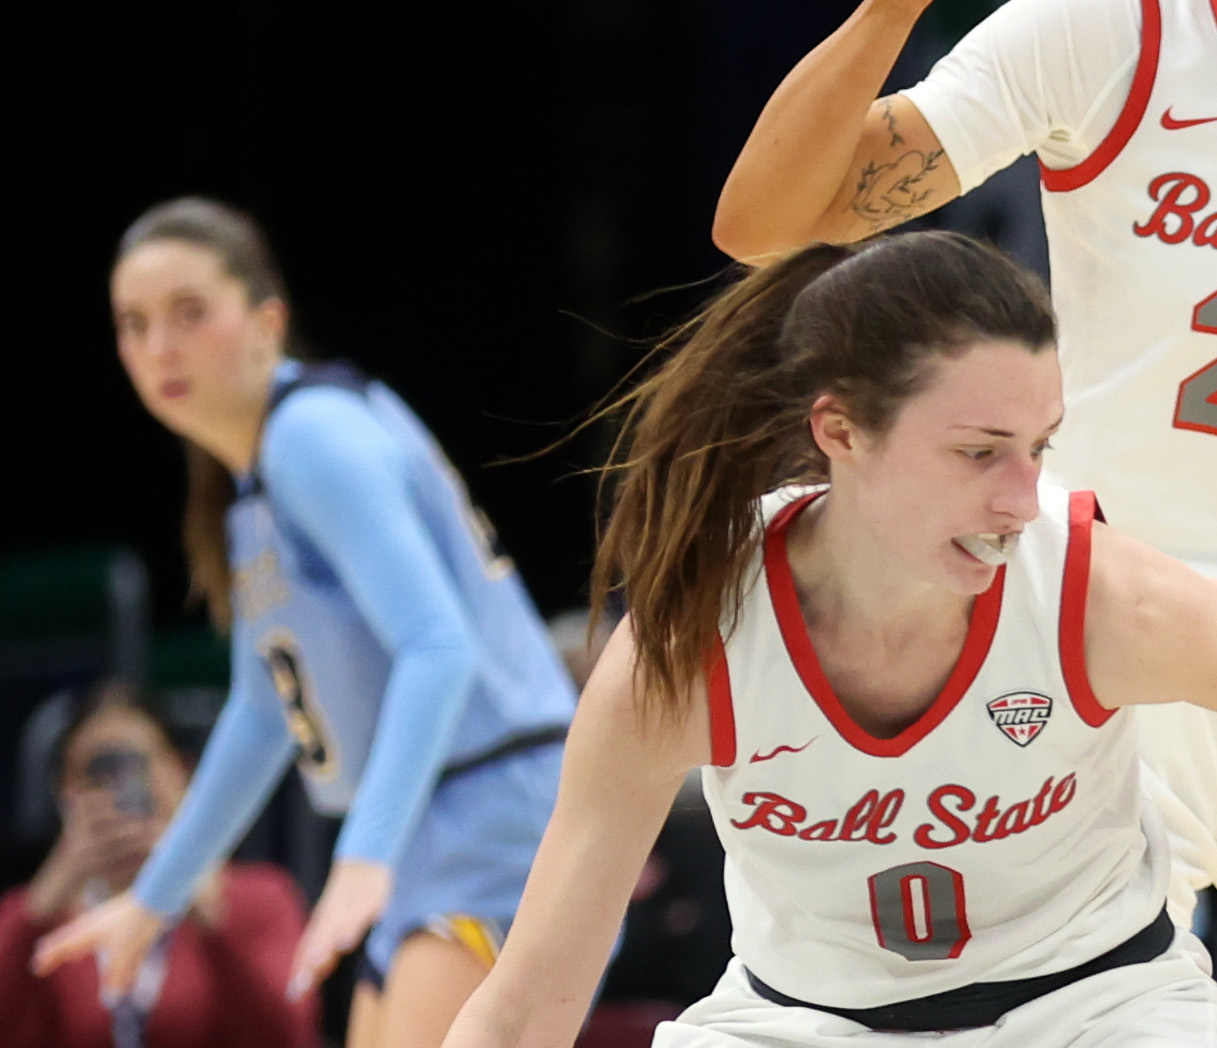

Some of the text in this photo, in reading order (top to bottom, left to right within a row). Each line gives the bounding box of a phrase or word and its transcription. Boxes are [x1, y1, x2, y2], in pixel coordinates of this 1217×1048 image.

[993, 708, 1050, 724] MAC
[730, 771, 1078, 849] Ball State
[867, 861, 973, 962] 0
